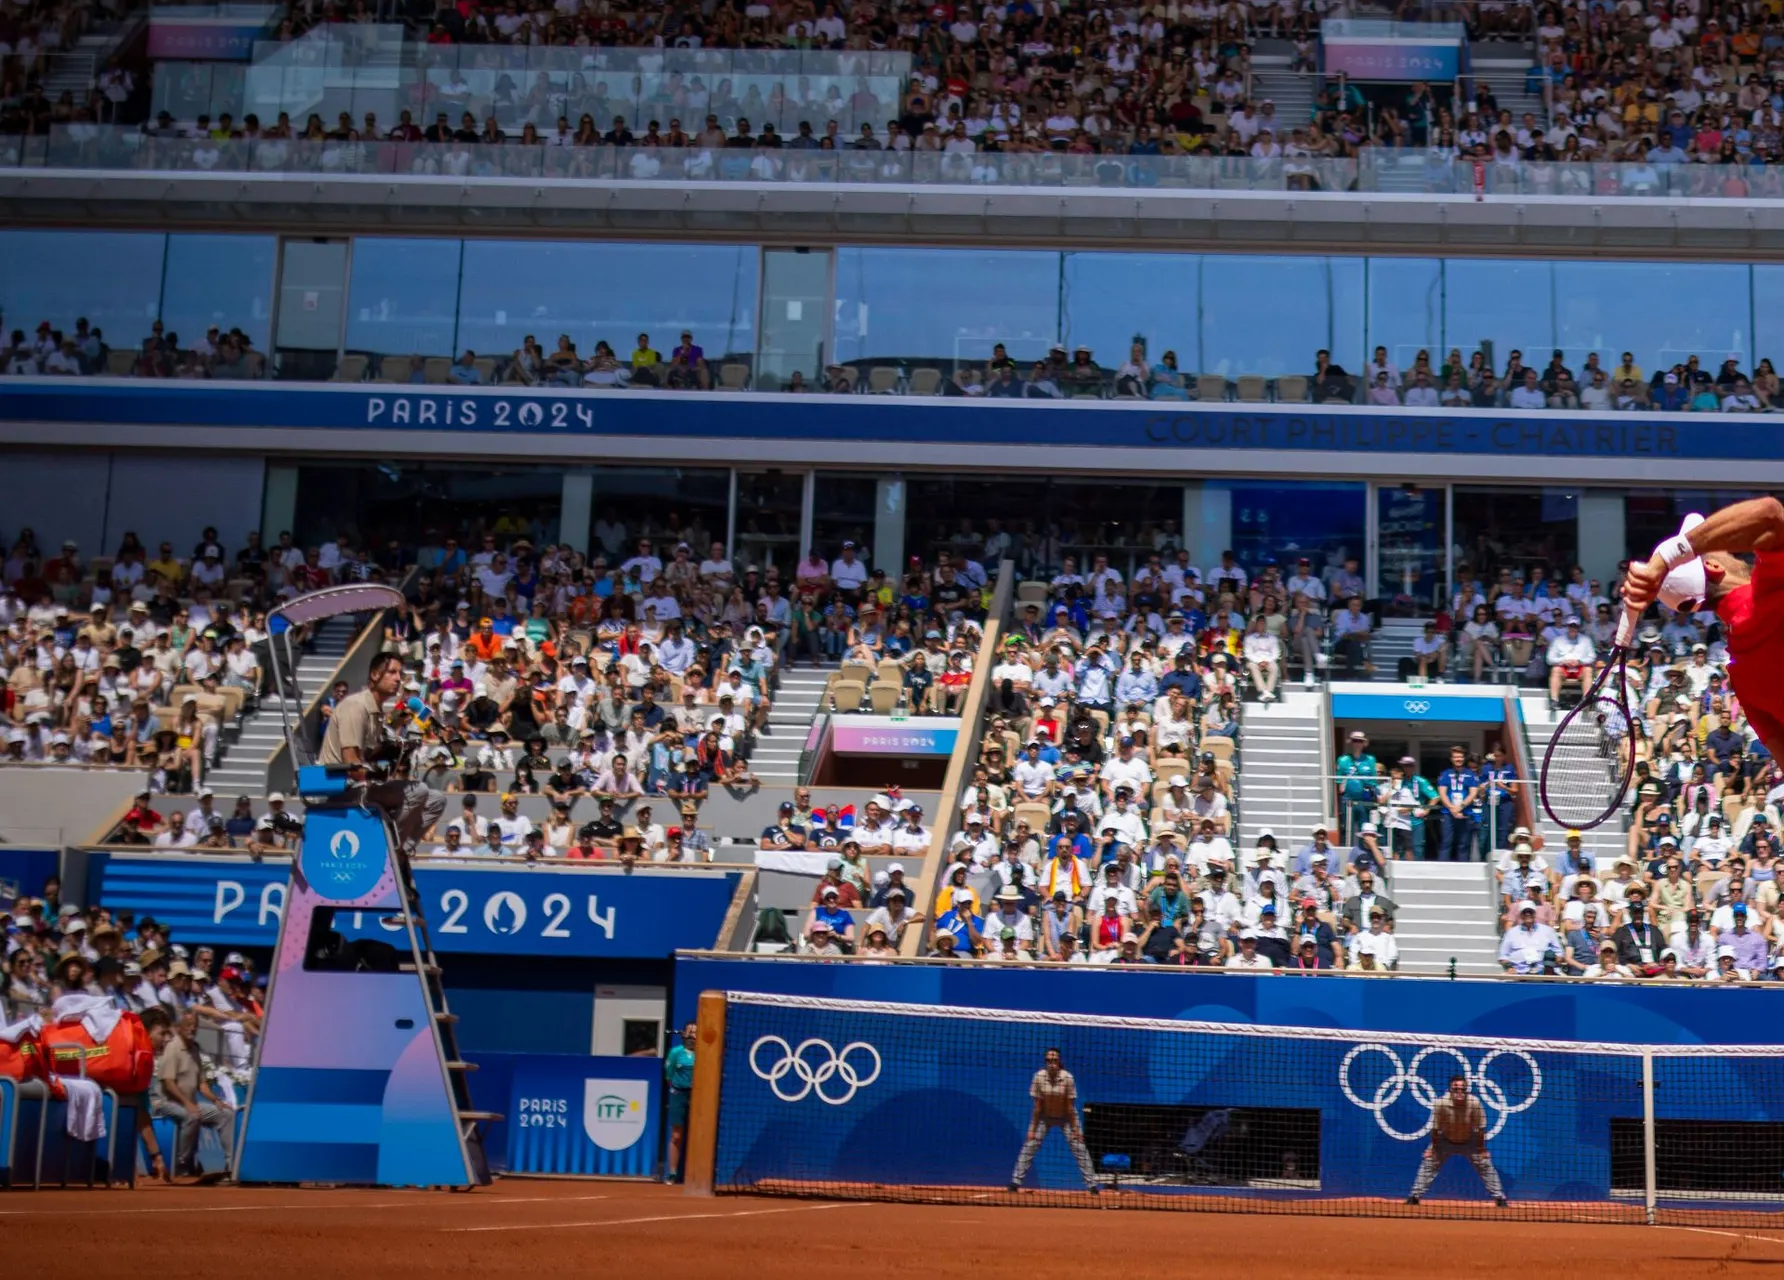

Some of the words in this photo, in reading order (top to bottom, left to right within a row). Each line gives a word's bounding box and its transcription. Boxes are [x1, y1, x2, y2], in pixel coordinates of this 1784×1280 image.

[1398, 57, 1444, 70] 2024
[494, 401, 593, 428] 2024
[1145, 415, 1277, 443] COURT
[1287, 418, 1455, 448] PHILIPPE
[1491, 422, 1678, 453] CHATRIER
[902, 737, 936, 747] 2024
[438, 888, 616, 940] 2024
[597, 1103, 627, 1119] ITF
[519, 1114, 567, 1129] 2024
